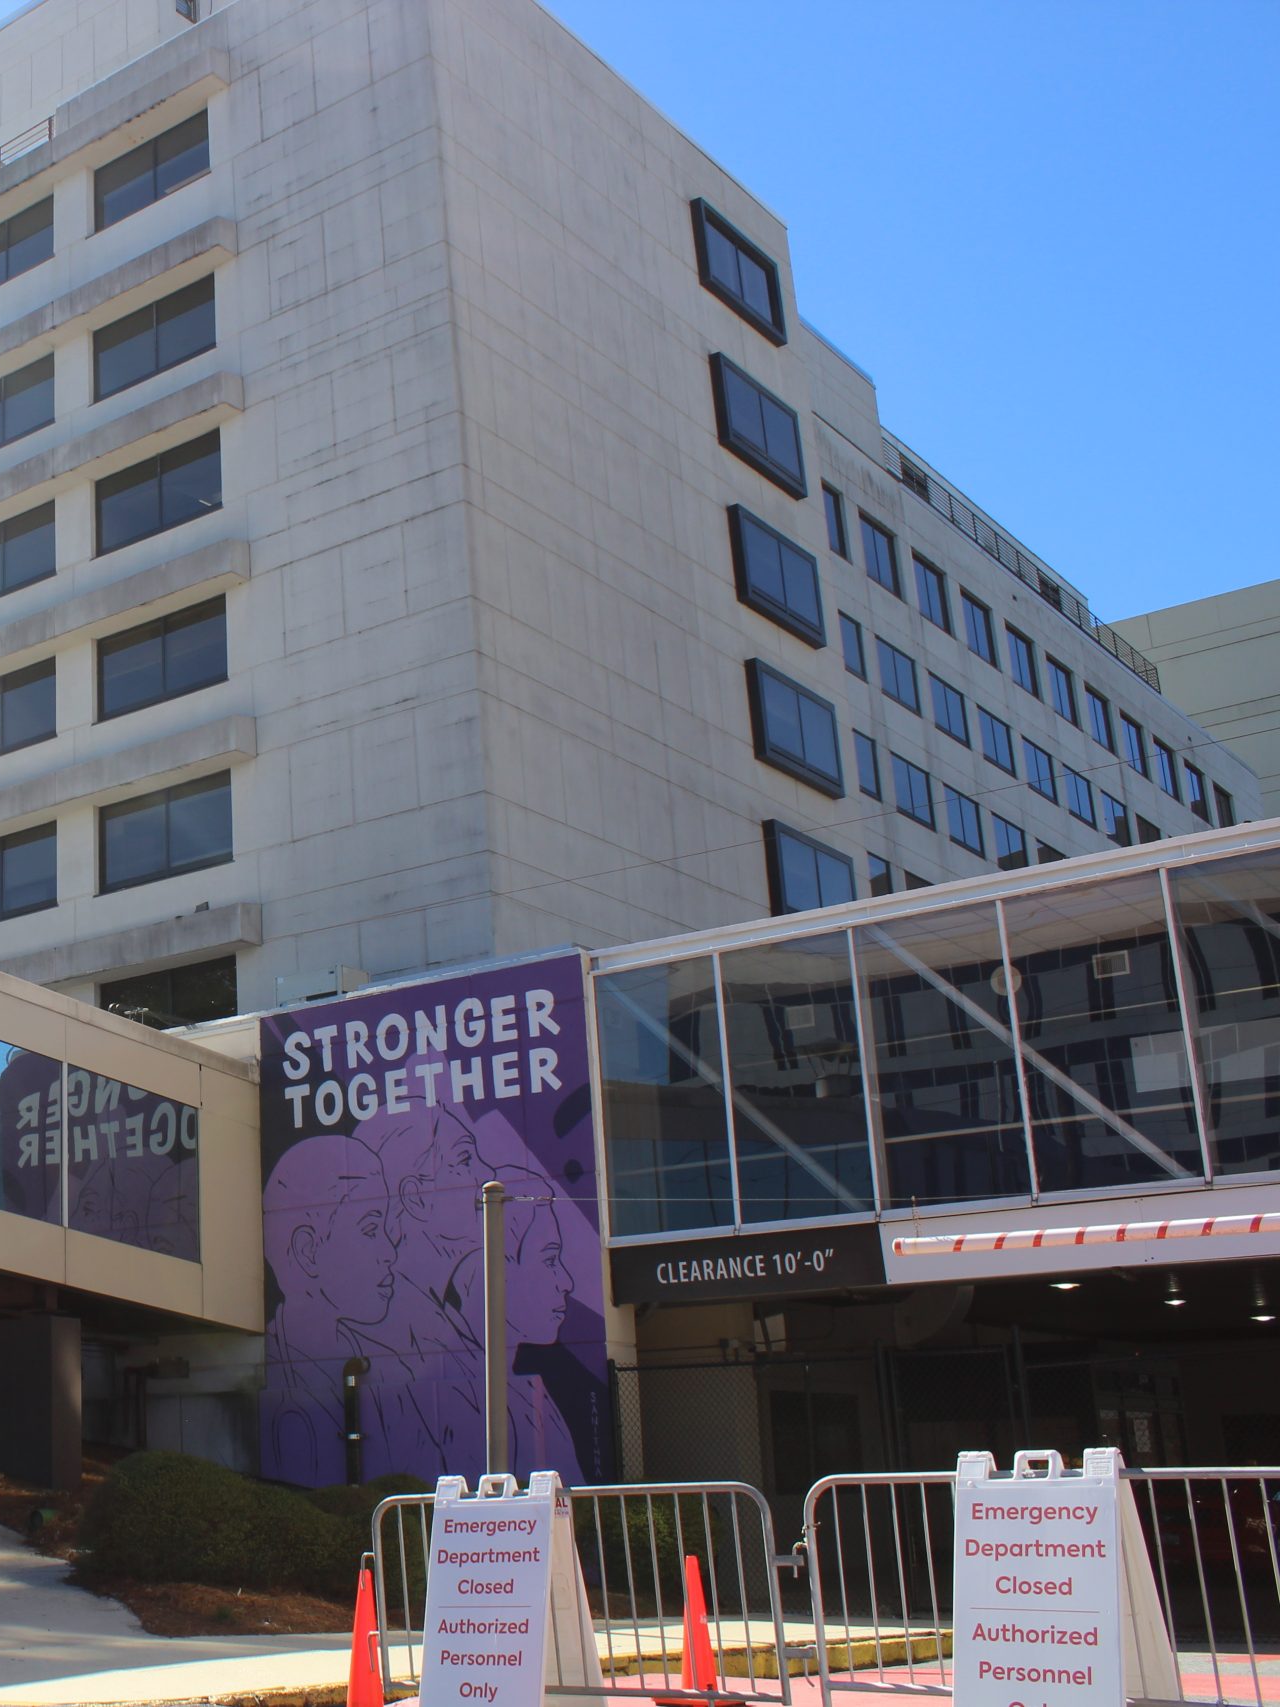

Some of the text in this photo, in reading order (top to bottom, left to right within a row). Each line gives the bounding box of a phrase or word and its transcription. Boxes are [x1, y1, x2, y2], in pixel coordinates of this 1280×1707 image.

[282, 989, 561, 1080] STRONGER
[284, 1047, 562, 1128] TOGETHER
[657, 1255, 766, 1284] CLEARANCE
[971, 1503, 1098, 1525] Emergency
[444, 1519, 537, 1536] Emergency
[437, 1547, 540, 1567] Department
[965, 1539, 1106, 1561] Department
[458, 1579, 514, 1594] Closed
[995, 1576, 1072, 1595] Closed
[438, 1619, 529, 1634] Authorized
[972, 1623, 1098, 1645] Authorized
[440, 1650, 522, 1666] Personnel
[979, 1661, 1092, 1685] Personnel
[459, 1682, 498, 1702] Only
